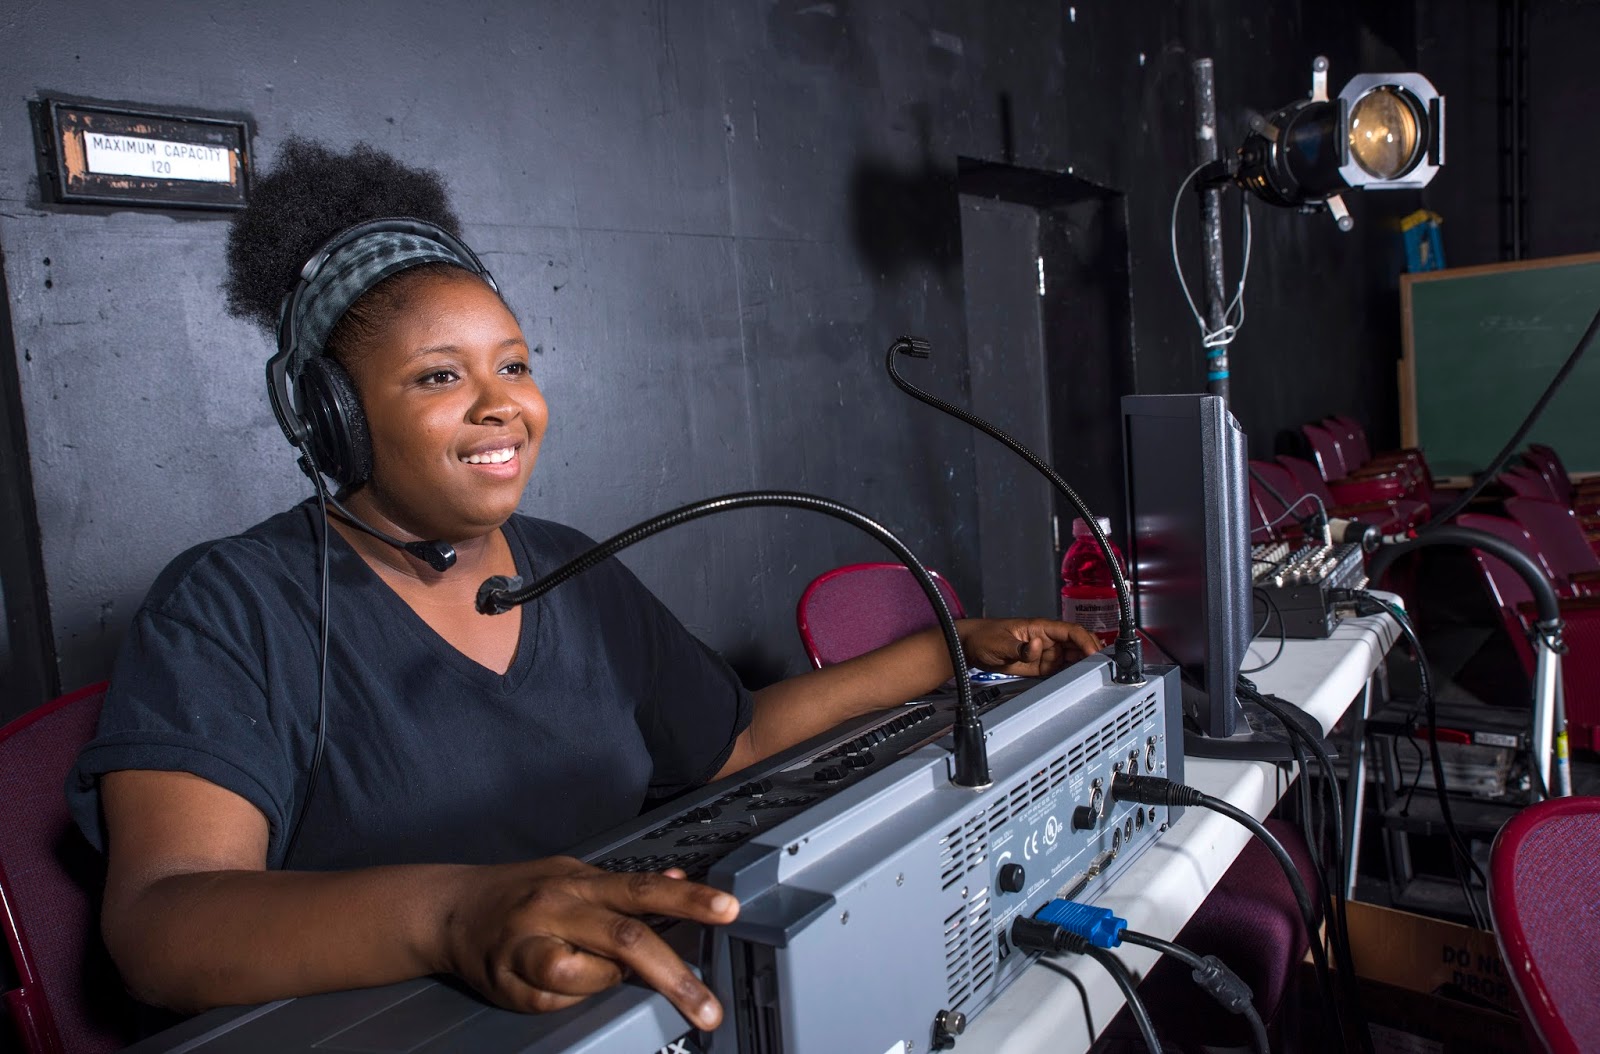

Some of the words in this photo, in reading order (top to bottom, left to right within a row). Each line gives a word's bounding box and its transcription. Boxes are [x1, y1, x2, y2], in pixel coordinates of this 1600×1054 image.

[93, 136, 156, 155] MAXIMUM
[164, 144, 221, 161] CAPACITY
[151, 160, 171, 174] 120
[1051, 786, 1064, 799] CPU
[1443, 945, 1470, 968] DO
[1478, 953, 1504, 977] NO
